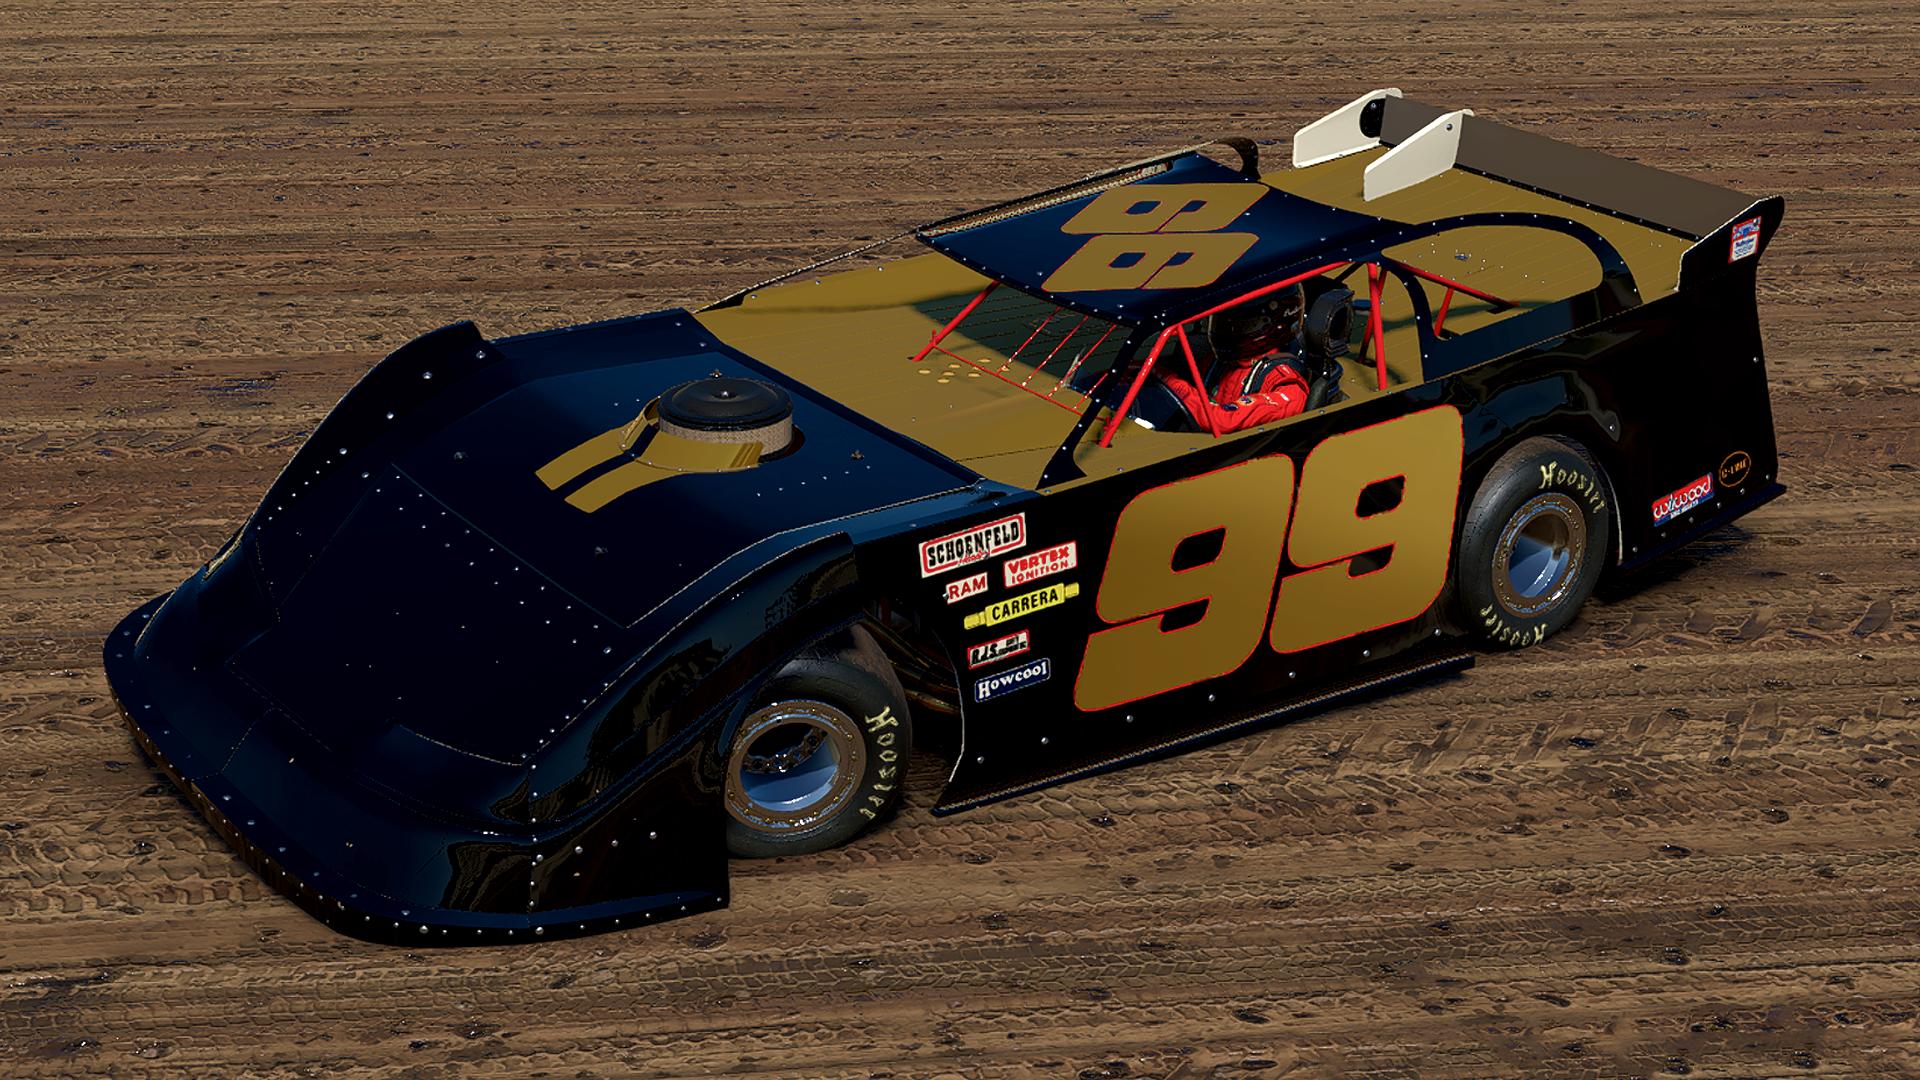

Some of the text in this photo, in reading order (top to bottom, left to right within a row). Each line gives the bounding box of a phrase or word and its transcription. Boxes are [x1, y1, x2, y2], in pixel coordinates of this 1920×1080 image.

[1041, 182, 1270, 292] 99
[927, 521, 1020, 567] SCHOENFELD
[1008, 546, 1070, 574] VERTEX
[1073, 404, 1464, 712] 99
[948, 575, 986, 600] RAM
[992, 588, 1059, 620] CARRERA
[977, 661, 1048, 699] Howcool
